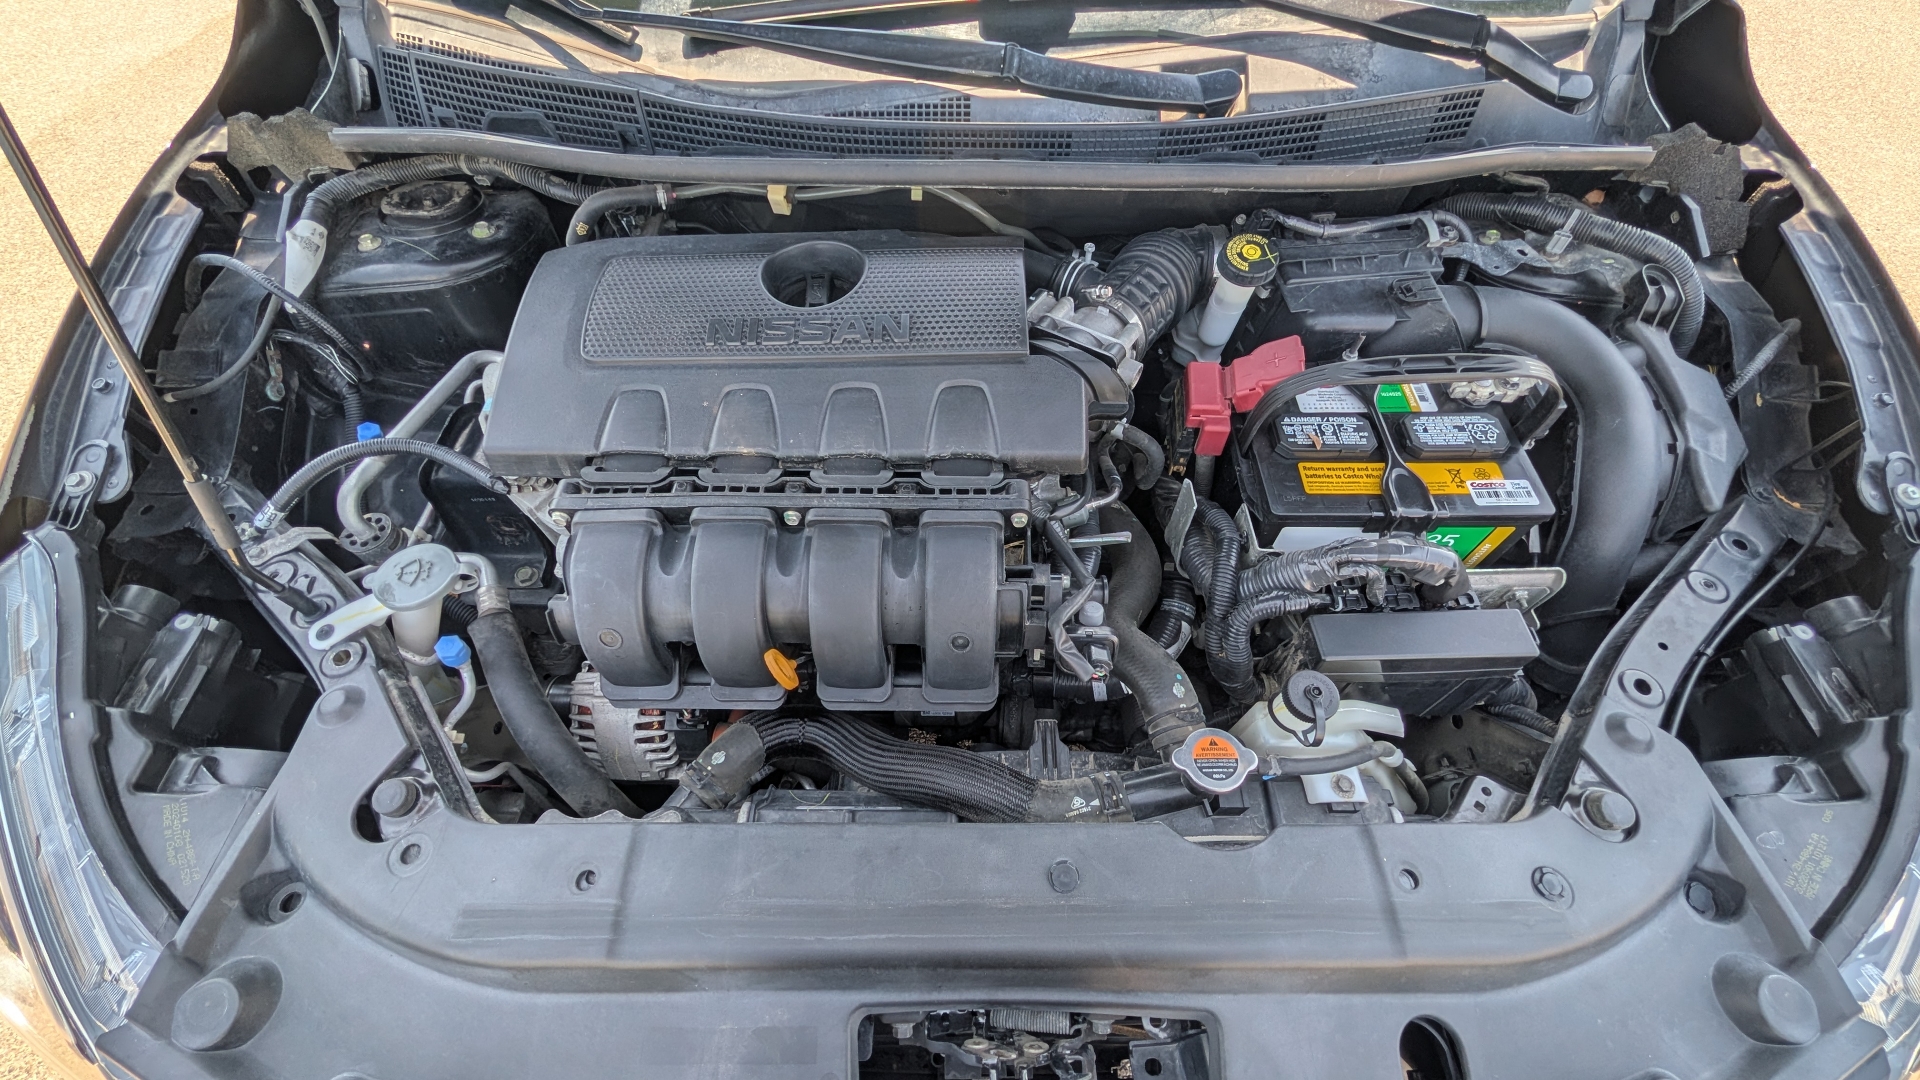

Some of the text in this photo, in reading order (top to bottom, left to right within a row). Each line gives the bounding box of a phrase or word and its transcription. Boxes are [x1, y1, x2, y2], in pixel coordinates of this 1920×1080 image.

[705, 313, 910, 346] NISSAN
[1325, 465, 1356, 473] warranty
[163, 804, 178, 866] MADE IN CHINA
